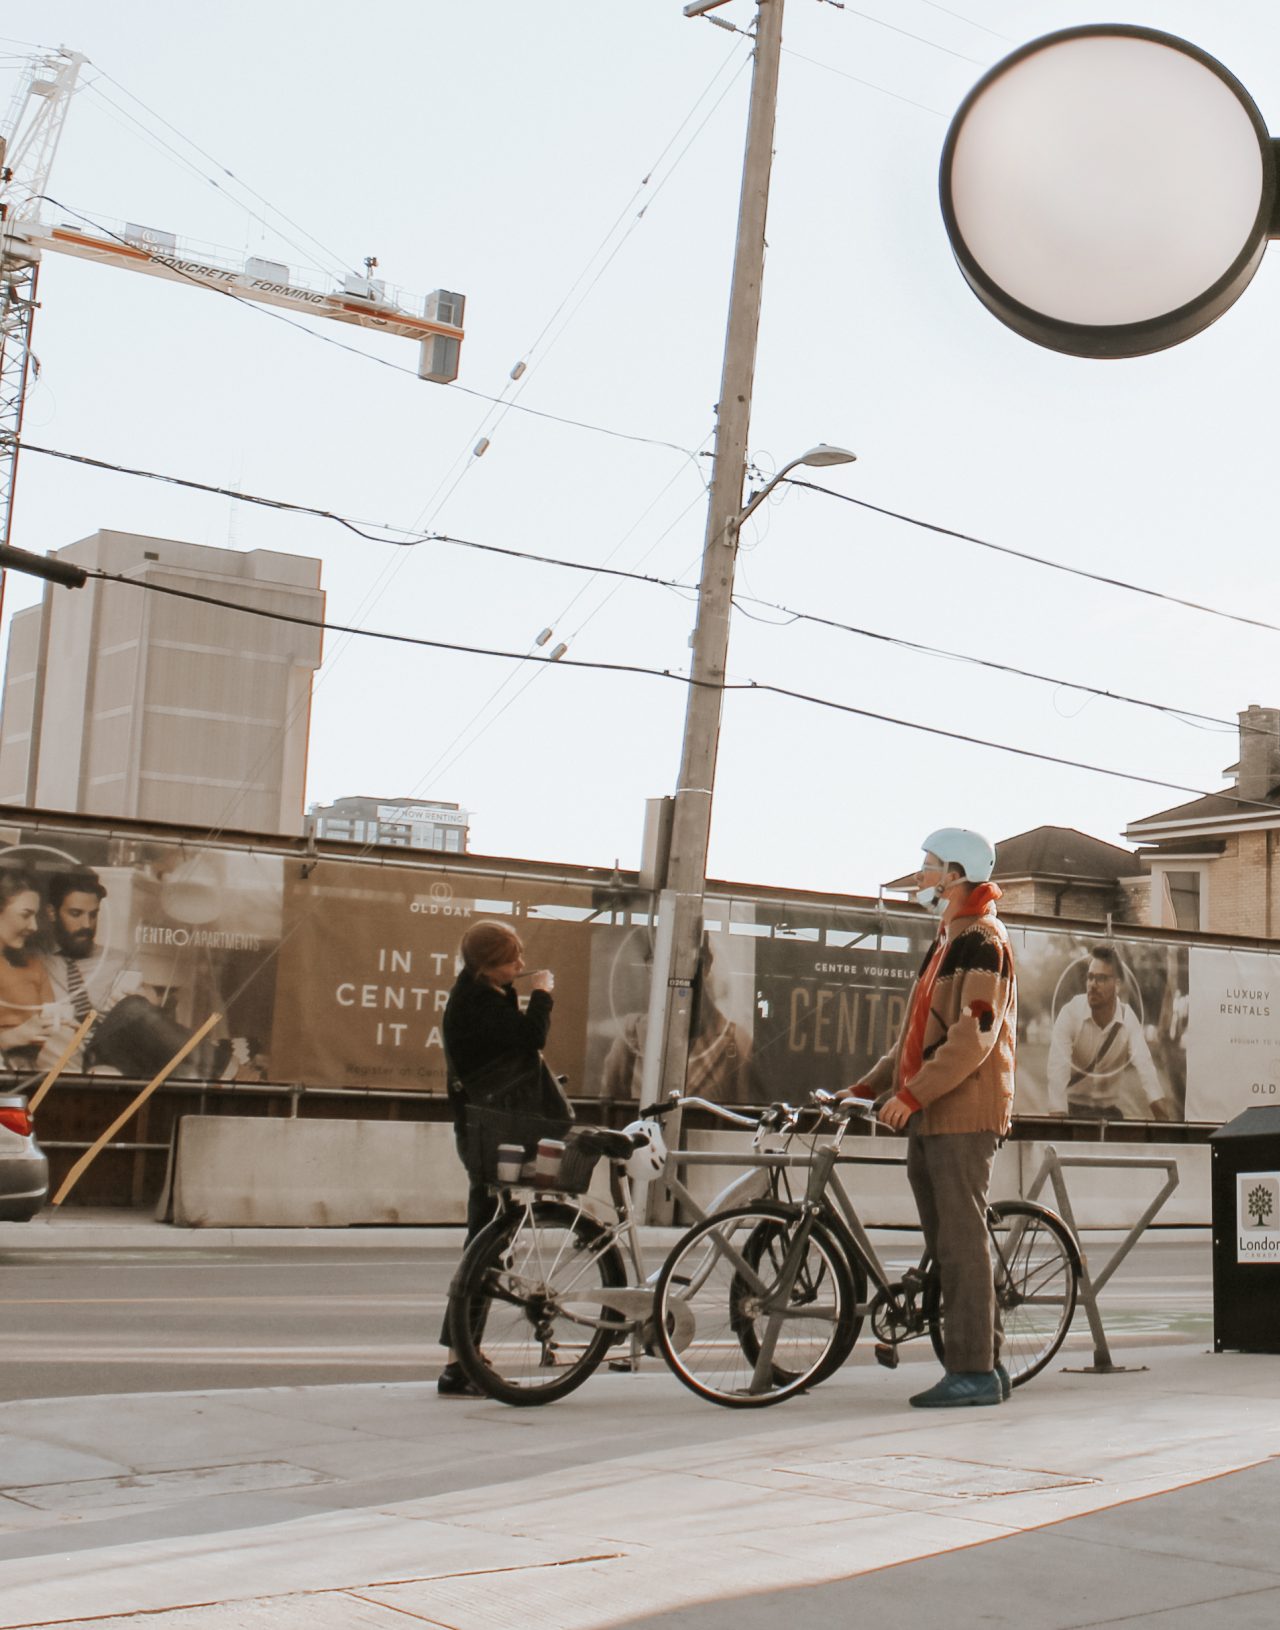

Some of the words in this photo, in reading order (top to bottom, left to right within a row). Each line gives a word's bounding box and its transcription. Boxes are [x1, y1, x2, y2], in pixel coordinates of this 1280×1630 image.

[151, 254, 239, 283] CONCRETE
[251, 279, 325, 304] FORMING
[402, 810, 424, 819] NOW
[424, 812, 464, 823] RENTING
[410, 902, 439, 915] OLD
[443, 905, 472, 918] OAK
[378, 949, 412, 974] IN
[814, 963, 857, 975] CENTRE
[336, 983, 450, 1012] CENTR
[1226, 989, 1270, 1001] LUXURY
[1220, 1004, 1271, 1017] RENTALS
[788, 987, 907, 1056] CENTR
[376, 1022, 408, 1047] IT
[1251, 1083, 1277, 1095] OLD
